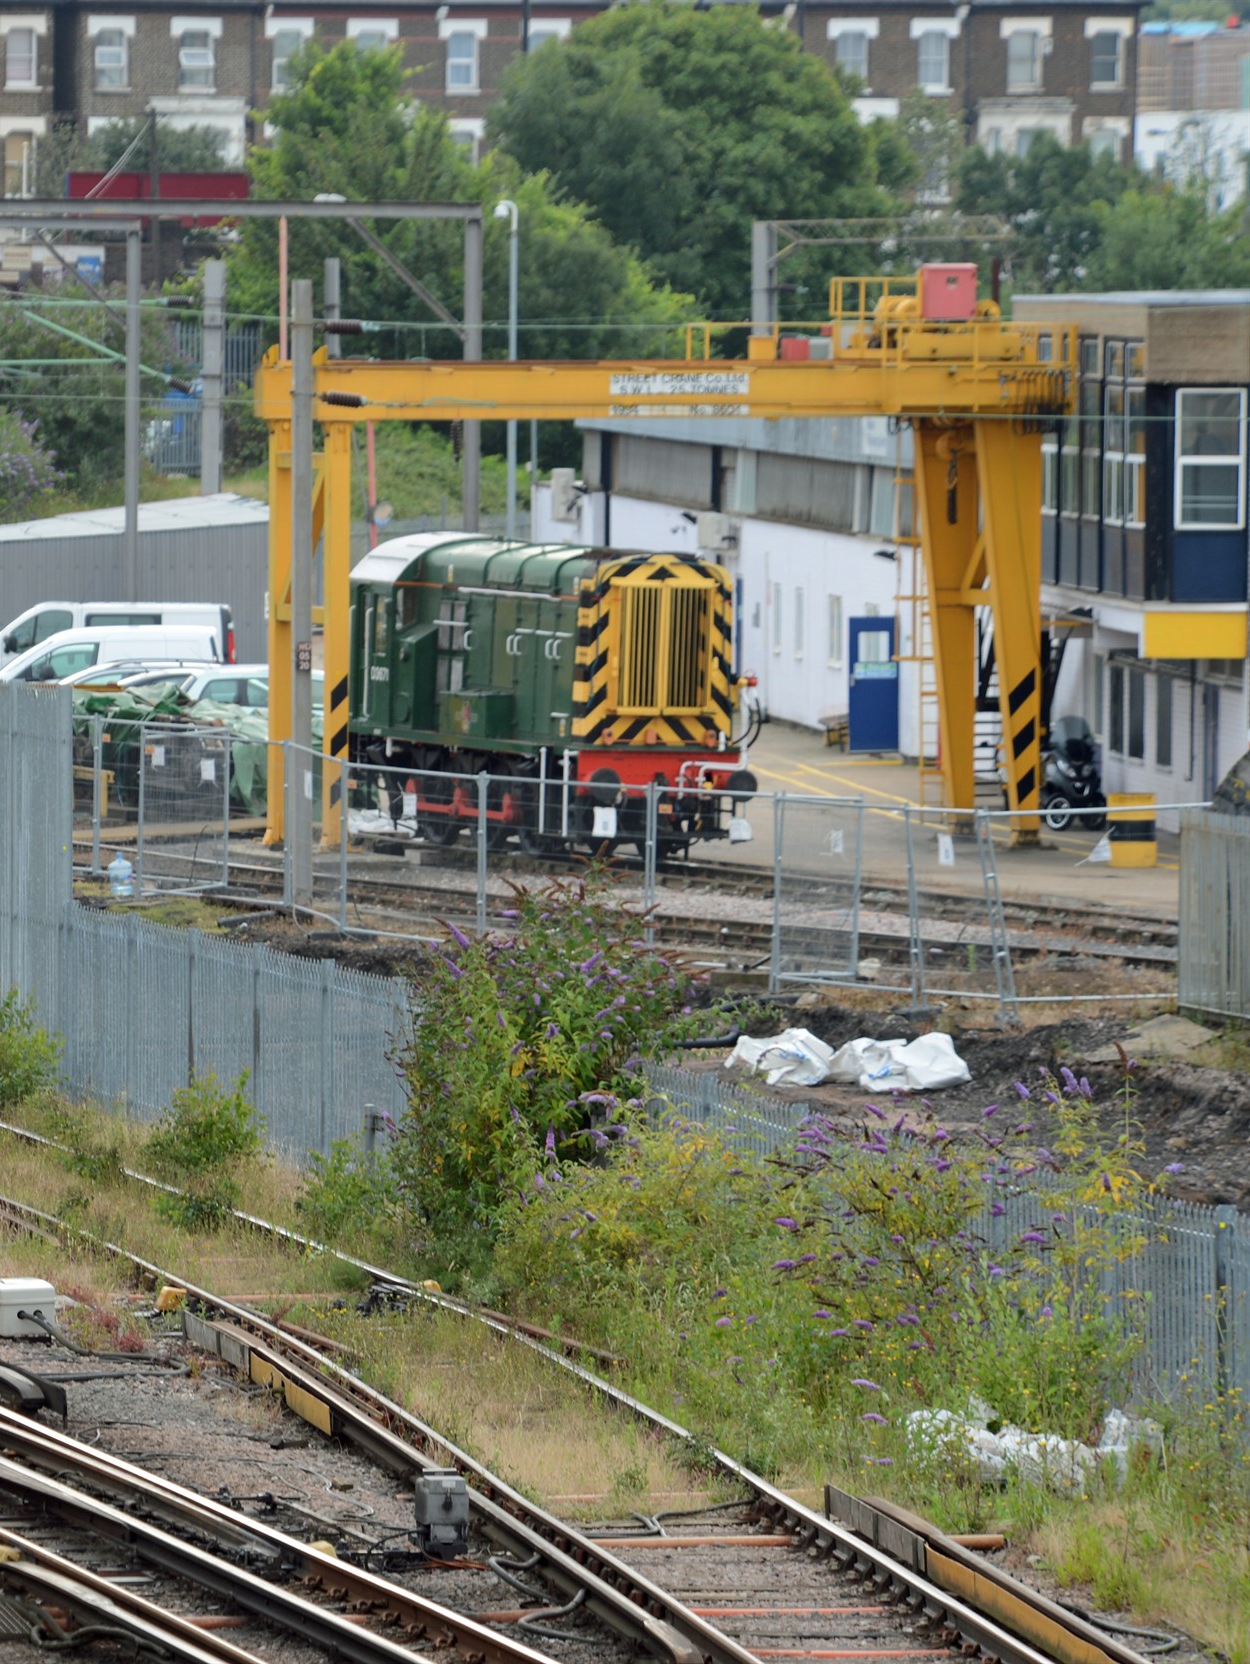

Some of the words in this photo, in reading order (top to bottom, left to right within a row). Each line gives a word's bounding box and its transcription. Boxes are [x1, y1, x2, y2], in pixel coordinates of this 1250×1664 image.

[613, 374, 657, 384] STREET
[662, 373, 702, 384] CRANE
[692, 384, 740, 395] TONNES
[299, 661, 310, 670] 20
